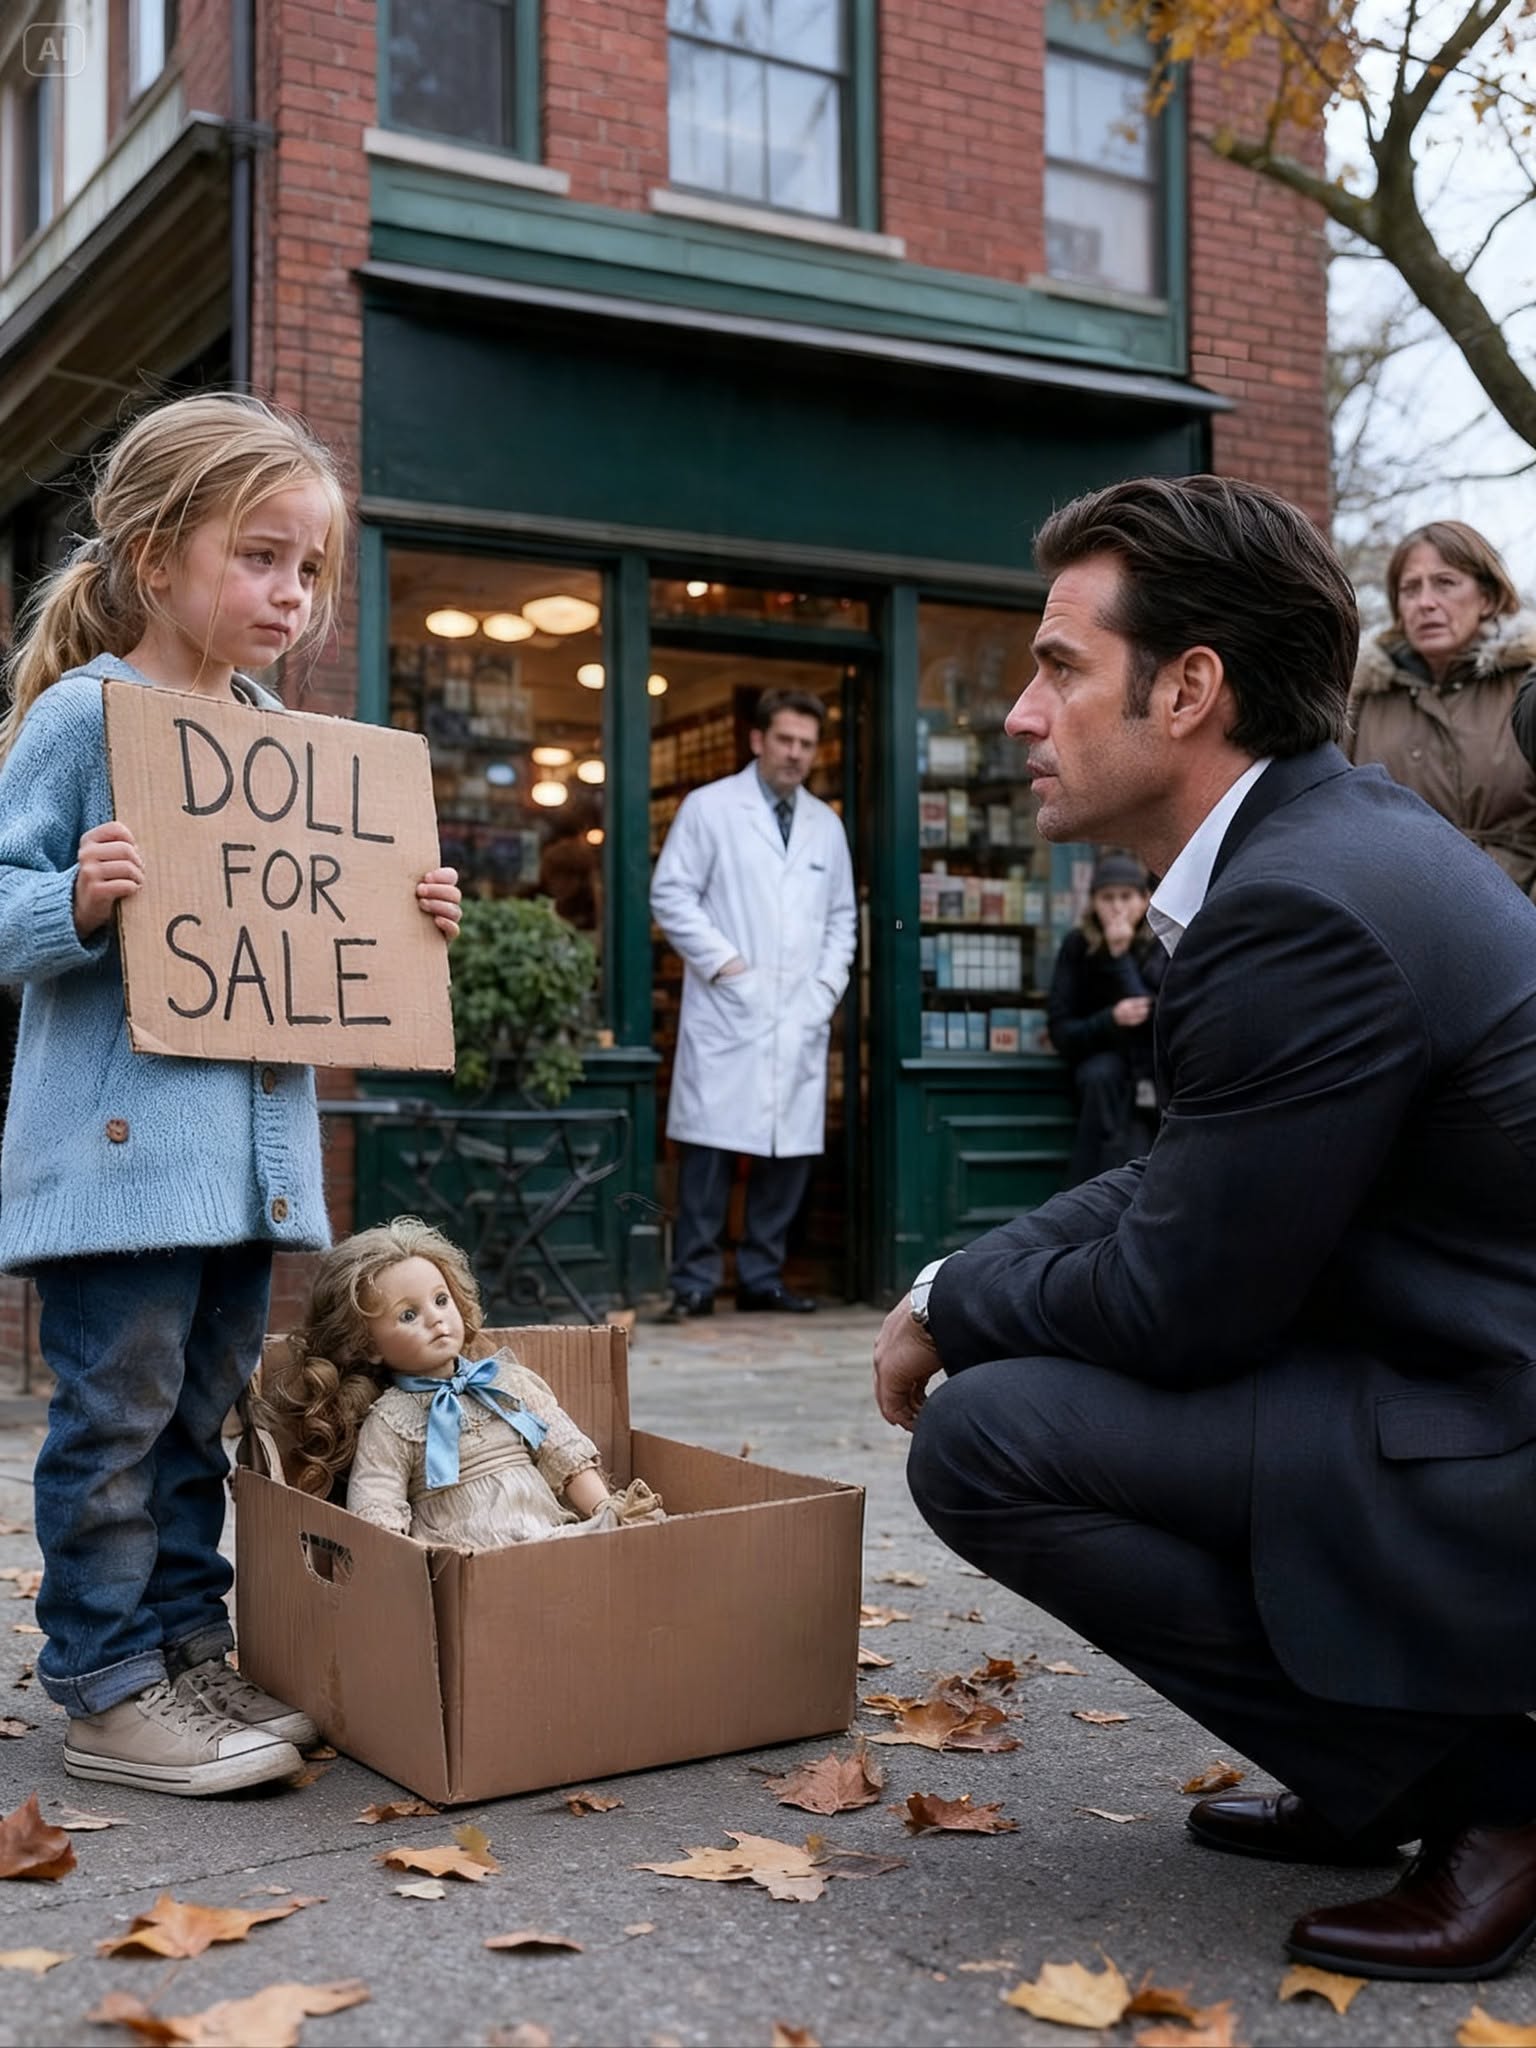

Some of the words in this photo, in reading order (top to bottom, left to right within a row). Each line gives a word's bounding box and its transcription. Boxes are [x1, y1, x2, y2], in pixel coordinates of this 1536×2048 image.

[173, 718, 395, 844] DOLL
[221, 842, 346, 923] FOR
[165, 914, 392, 1027] SALE
